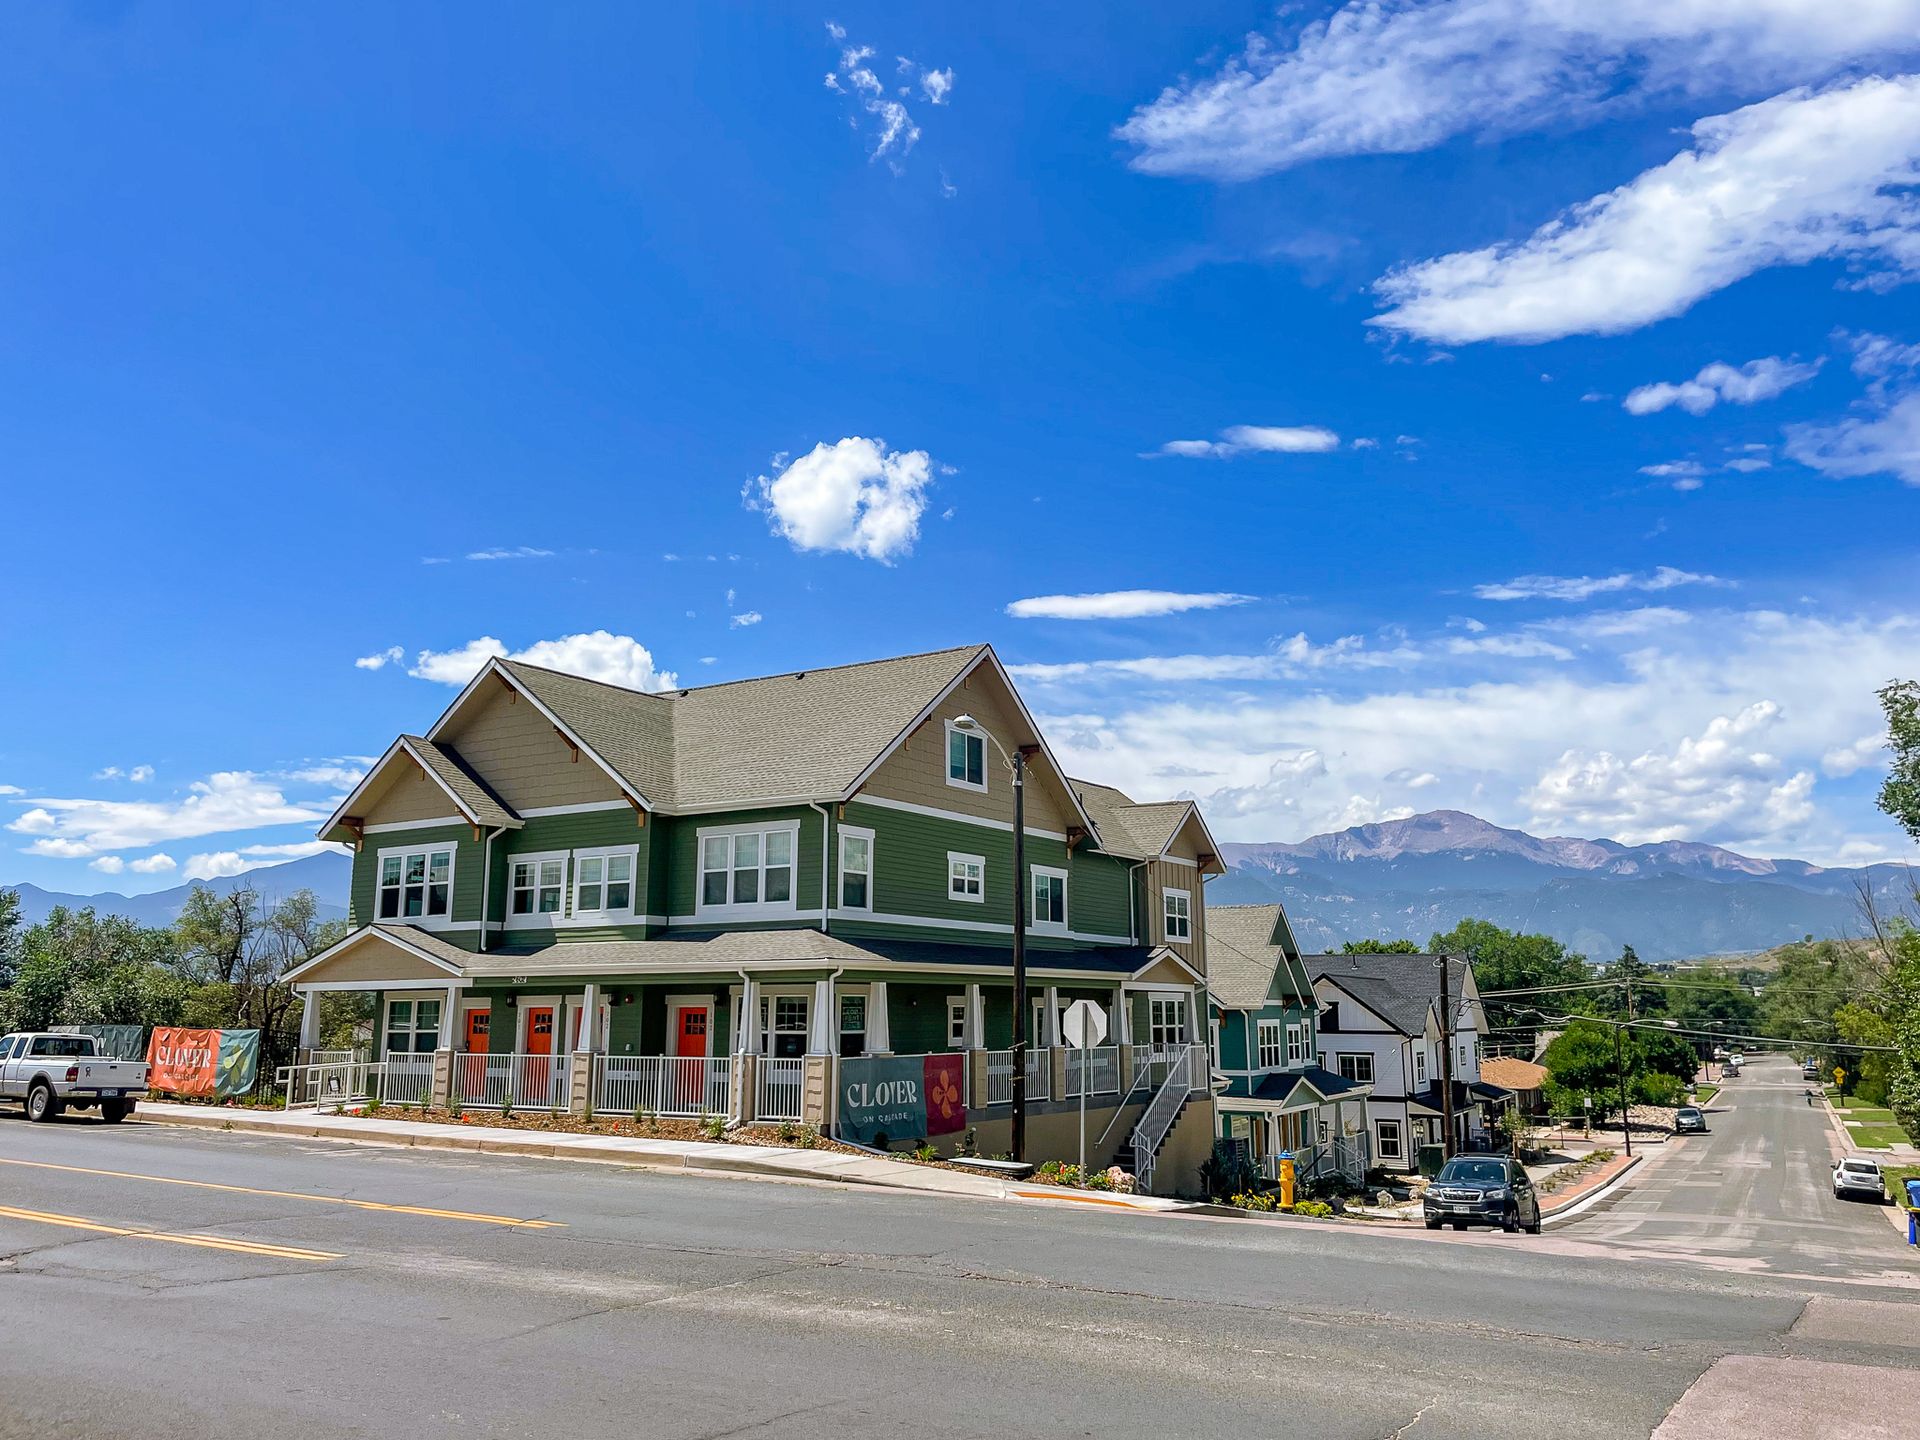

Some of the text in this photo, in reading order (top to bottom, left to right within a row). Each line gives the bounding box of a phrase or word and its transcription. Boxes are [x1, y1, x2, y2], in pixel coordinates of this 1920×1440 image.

[155, 1046, 212, 1069] CLOVER
[847, 1080, 918, 1108] CLOVER
[862, 1115, 875, 1124] ON
